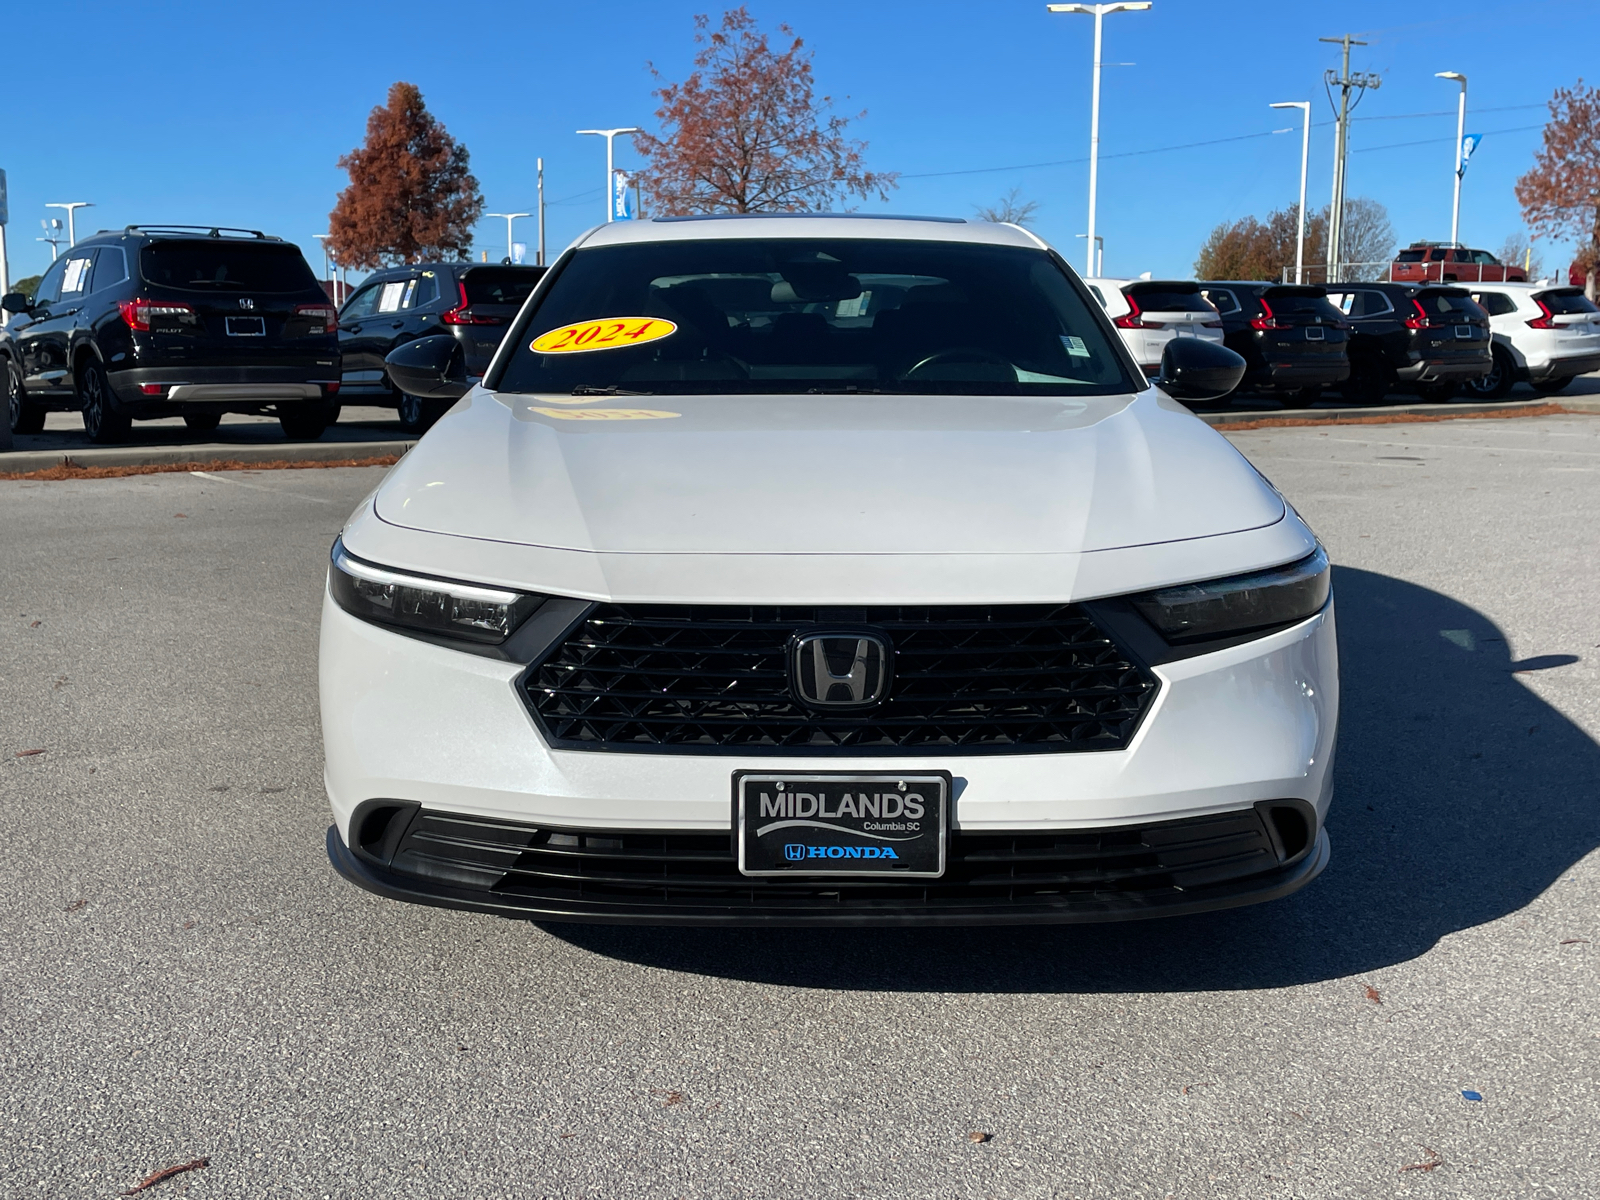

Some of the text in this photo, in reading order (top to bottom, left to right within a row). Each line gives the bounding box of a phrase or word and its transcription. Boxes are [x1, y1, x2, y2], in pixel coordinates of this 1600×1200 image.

[548, 321, 655, 350] 2024
[759, 792, 925, 819] MIDLANDS
[863, 821, 920, 831] Columbia SC
[807, 846, 899, 859] HONDA
